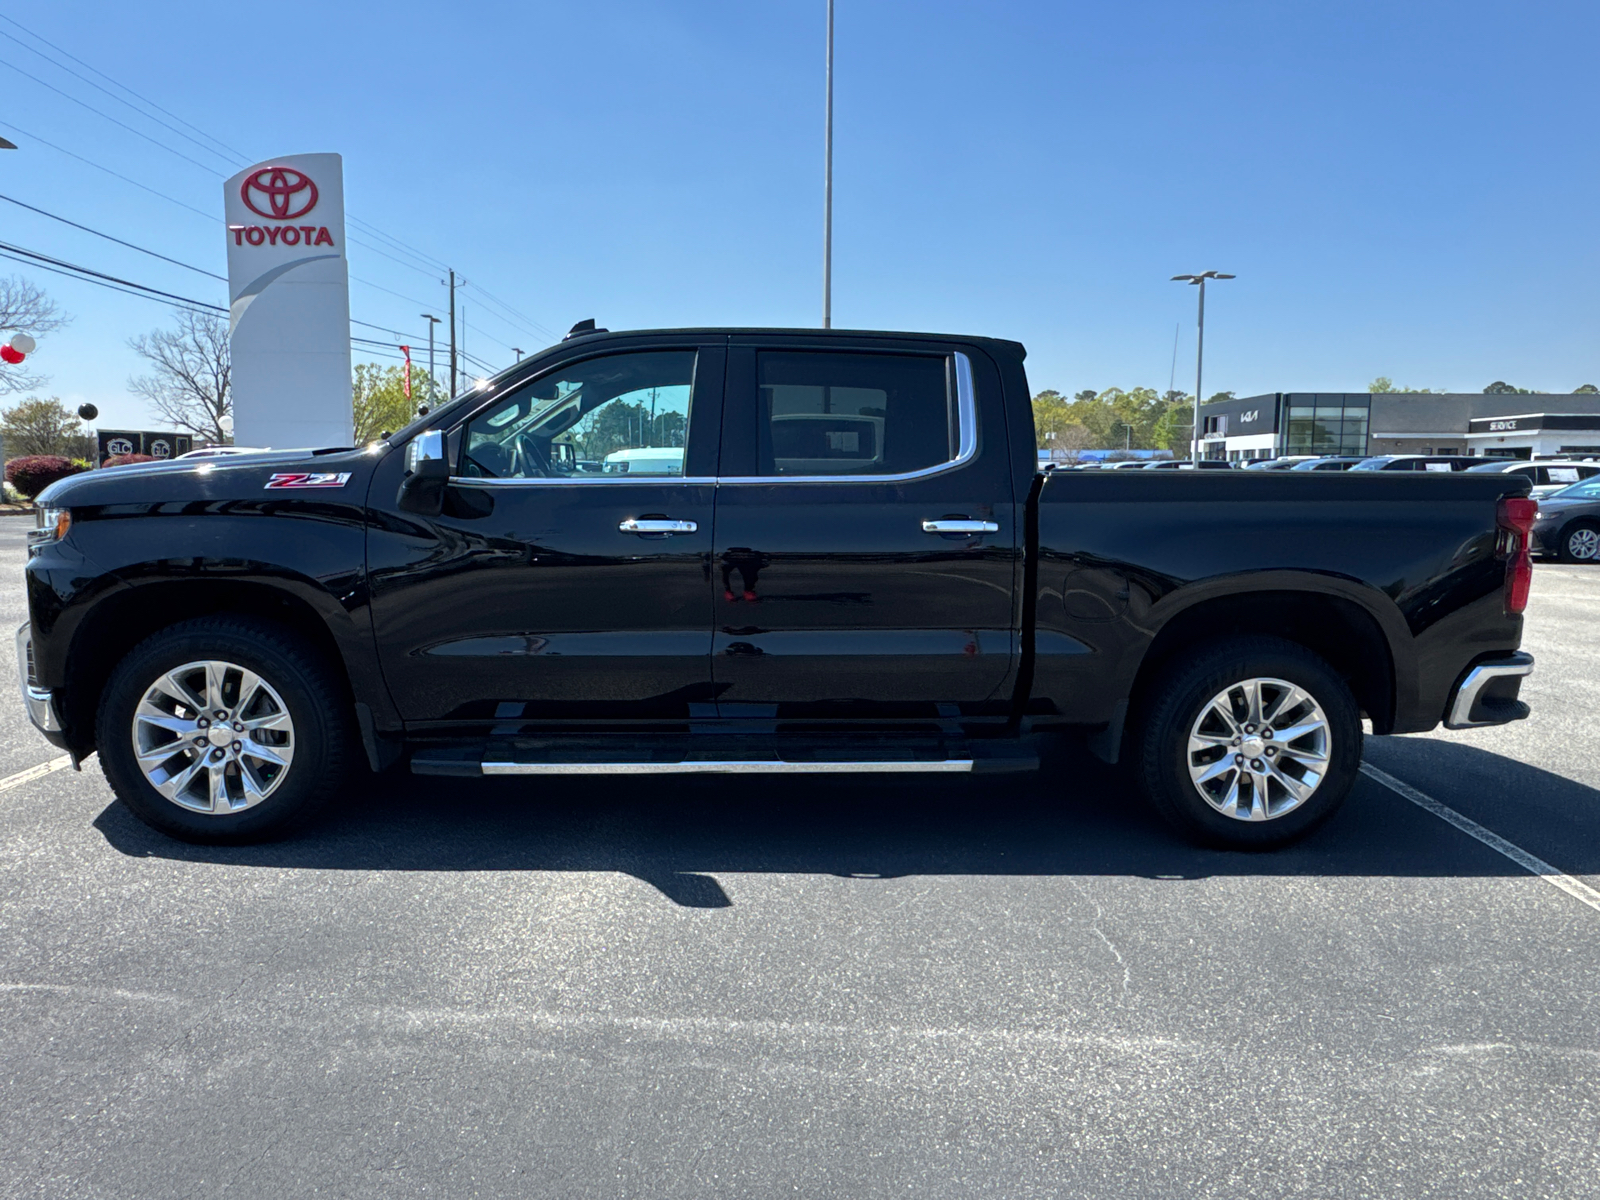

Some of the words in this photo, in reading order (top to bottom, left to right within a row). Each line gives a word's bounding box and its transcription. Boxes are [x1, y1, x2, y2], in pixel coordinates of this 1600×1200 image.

[229, 225, 334, 246] TOYOTA
[1490, 420, 1517, 430] SERVICE
[110, 443, 131, 454] GLC
[154, 445, 168, 456] GLC
[263, 472, 352, 489] Z71
